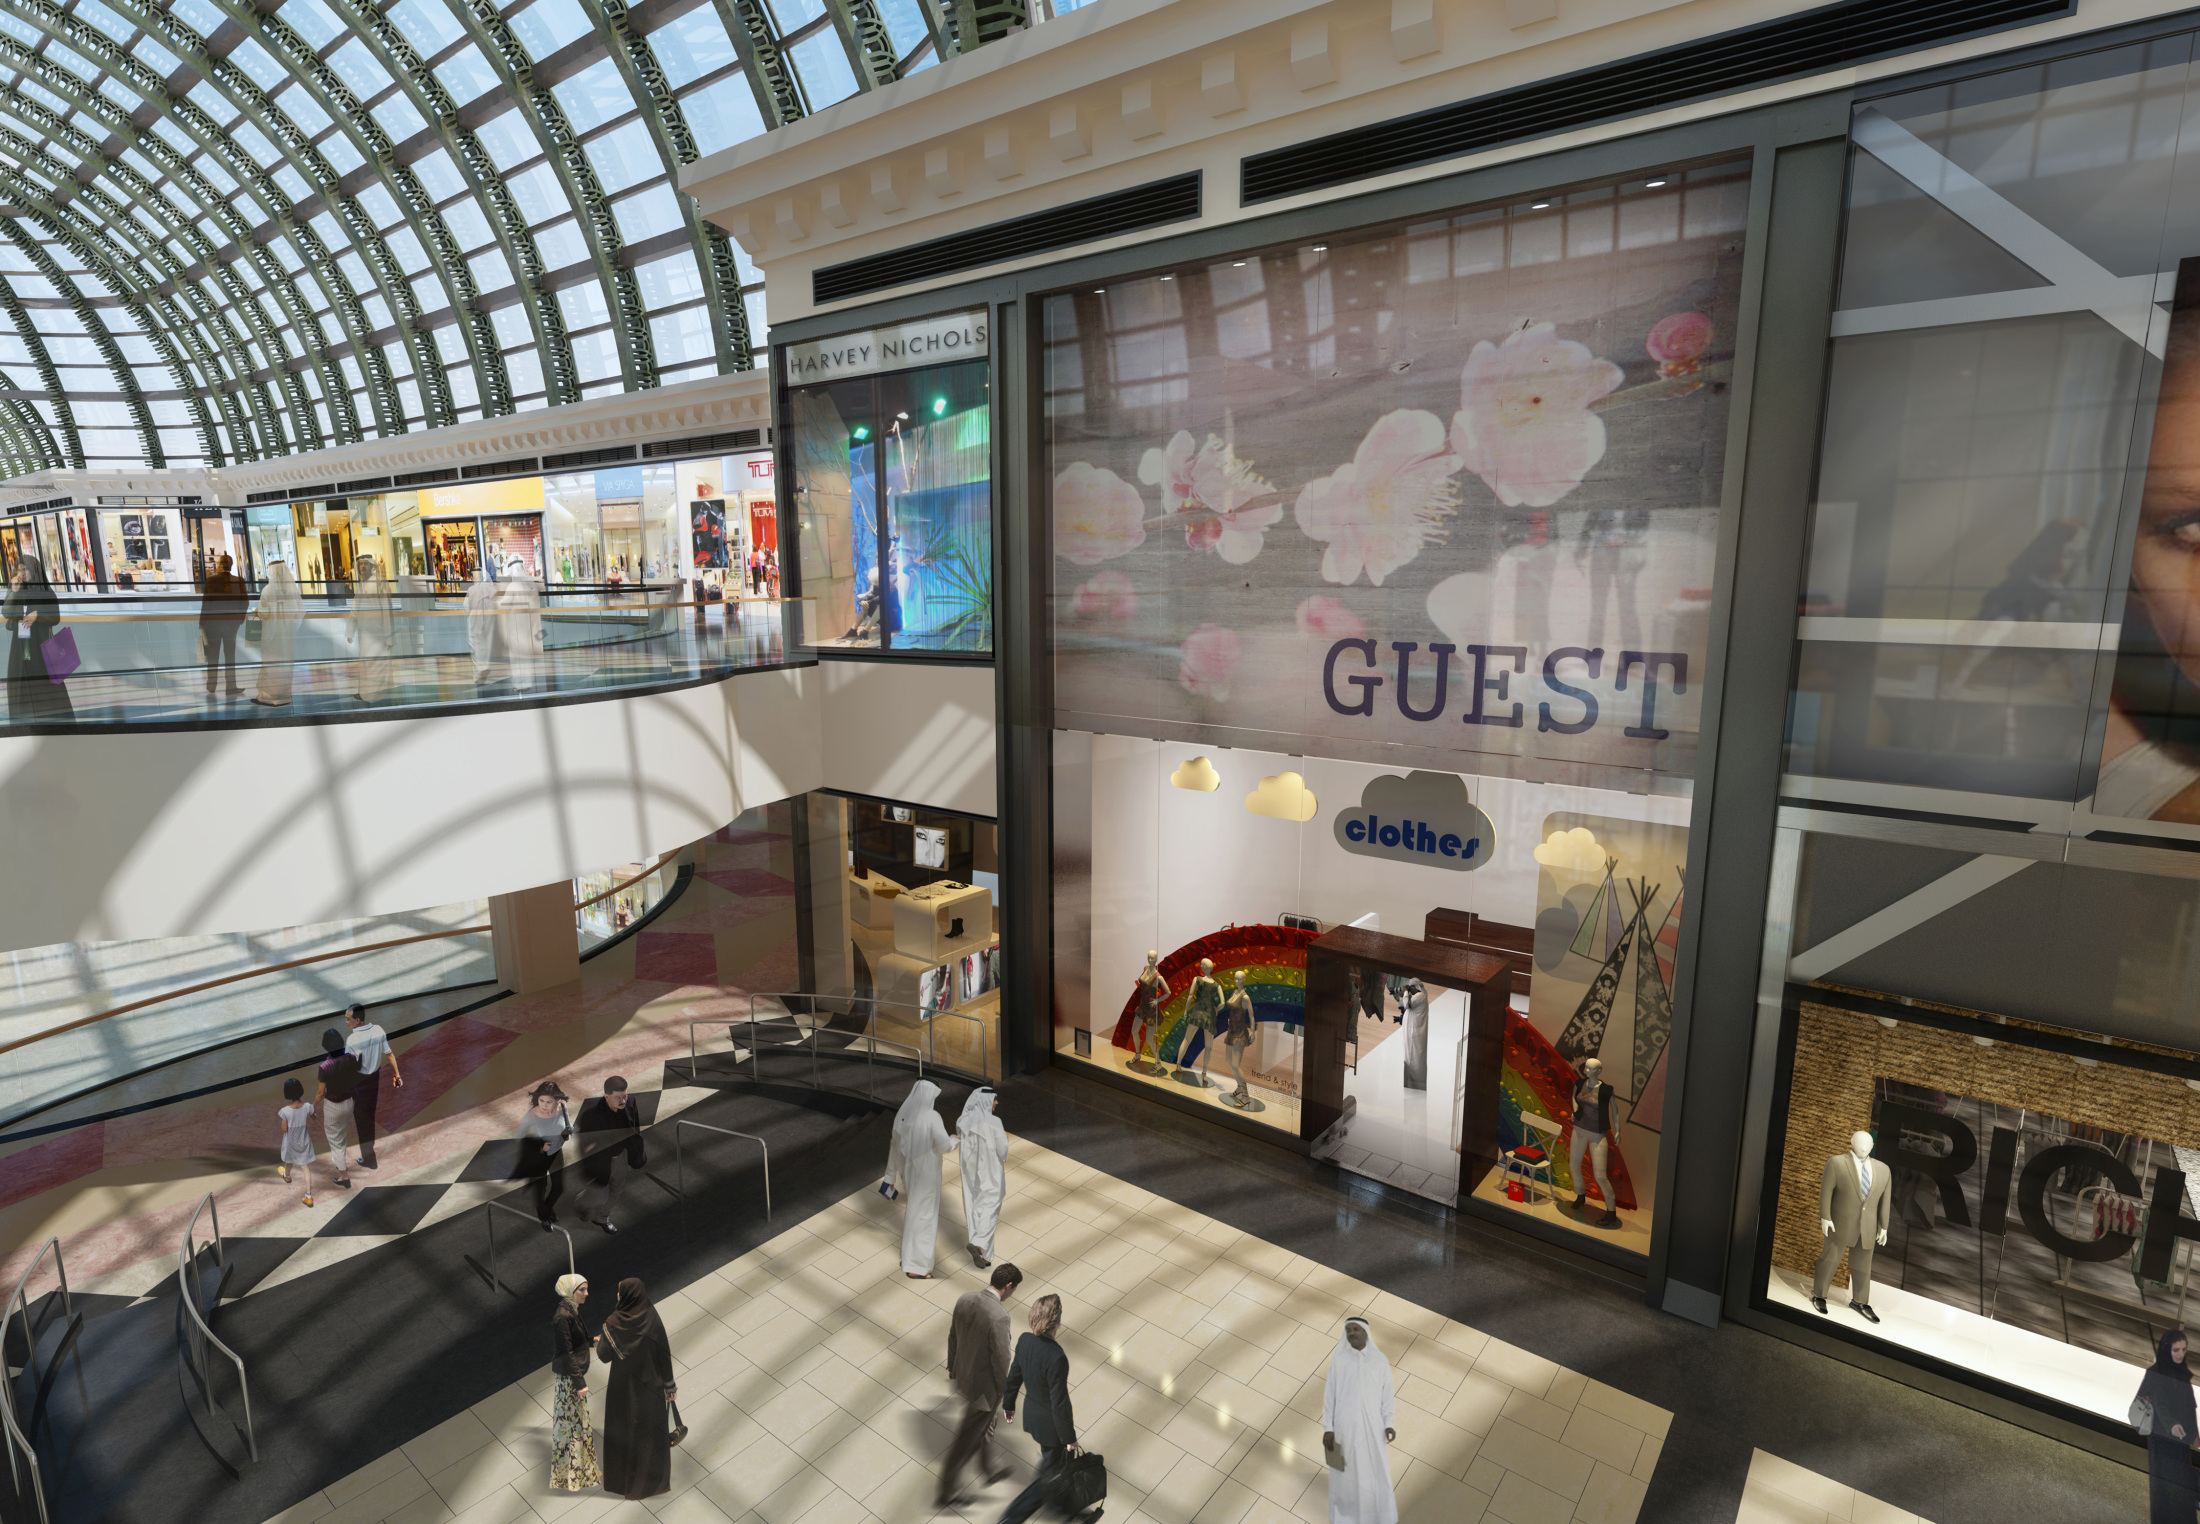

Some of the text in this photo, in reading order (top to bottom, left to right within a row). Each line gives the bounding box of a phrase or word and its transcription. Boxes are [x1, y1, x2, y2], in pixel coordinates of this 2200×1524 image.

[790, 325, 986, 374] HARVEY NICHOLS
[433, 491, 461, 507] Bershka
[602, 480, 614, 491] VIA
[1323, 638, 1689, 740] GUEST
[1345, 815, 1480, 860] clothes
[1251, 1069, 1272, 1082] trend
[1273, 1076, 1279, 1084] &
